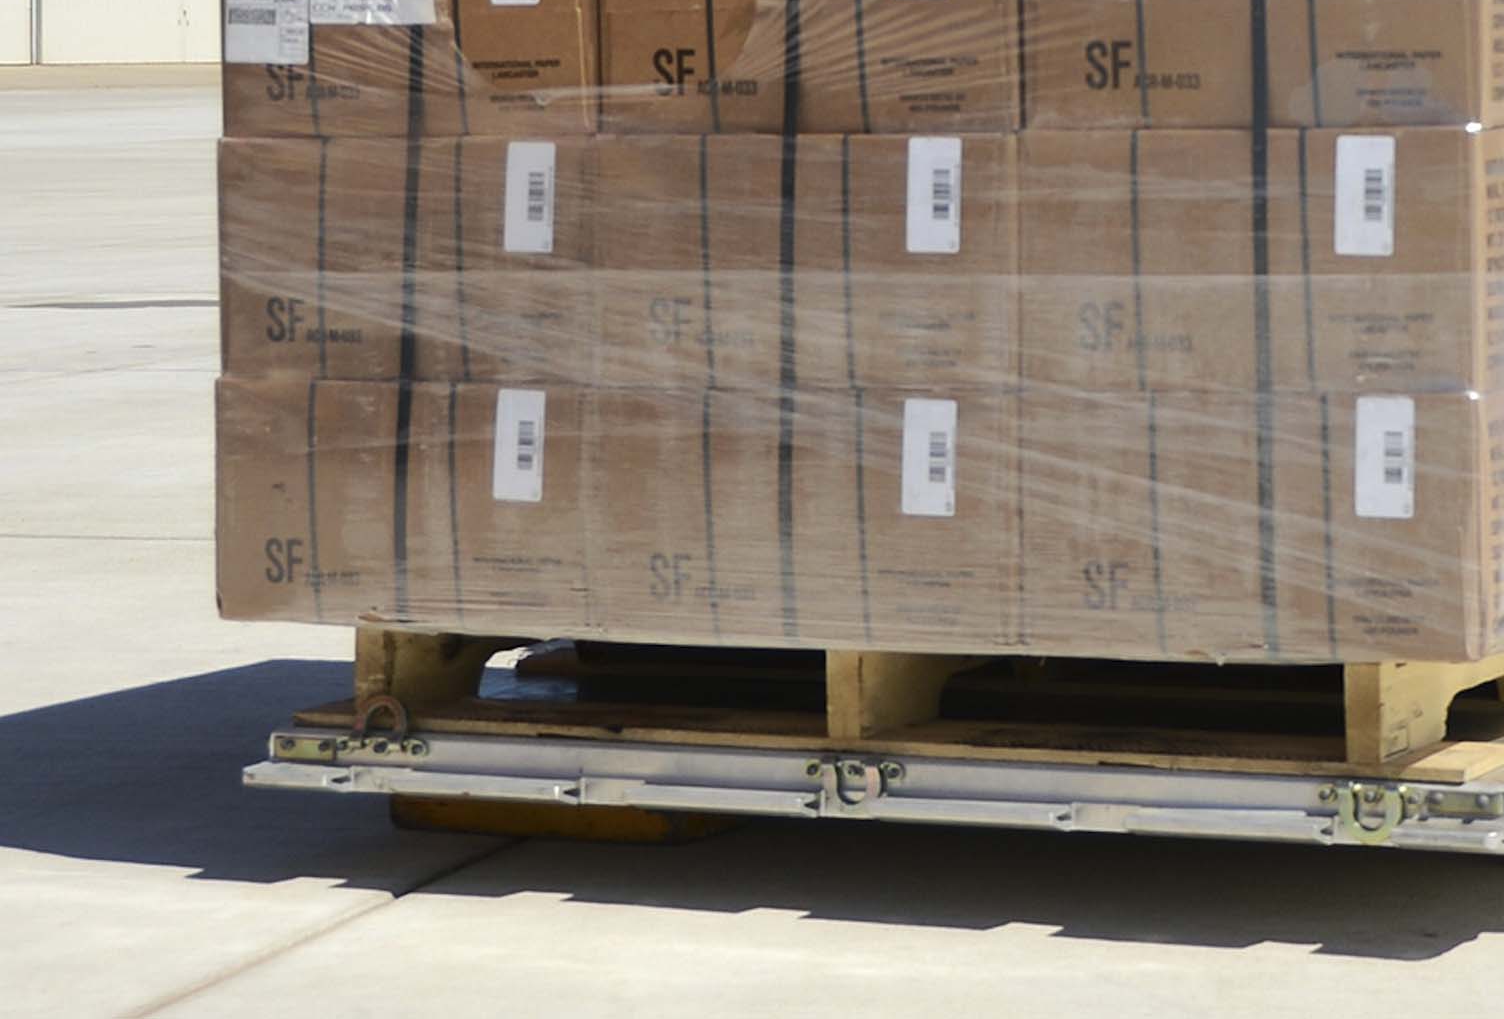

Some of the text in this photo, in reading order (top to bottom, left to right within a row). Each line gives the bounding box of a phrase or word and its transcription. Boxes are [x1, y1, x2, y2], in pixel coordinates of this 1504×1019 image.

[653, 48, 695, 97] SF
[1086, 40, 1132, 91] SF
[266, 296, 304, 342] SF
[264, 537, 303, 584] SF
[649, 552, 692, 602] SF
[1082, 562, 1128, 612] SF
